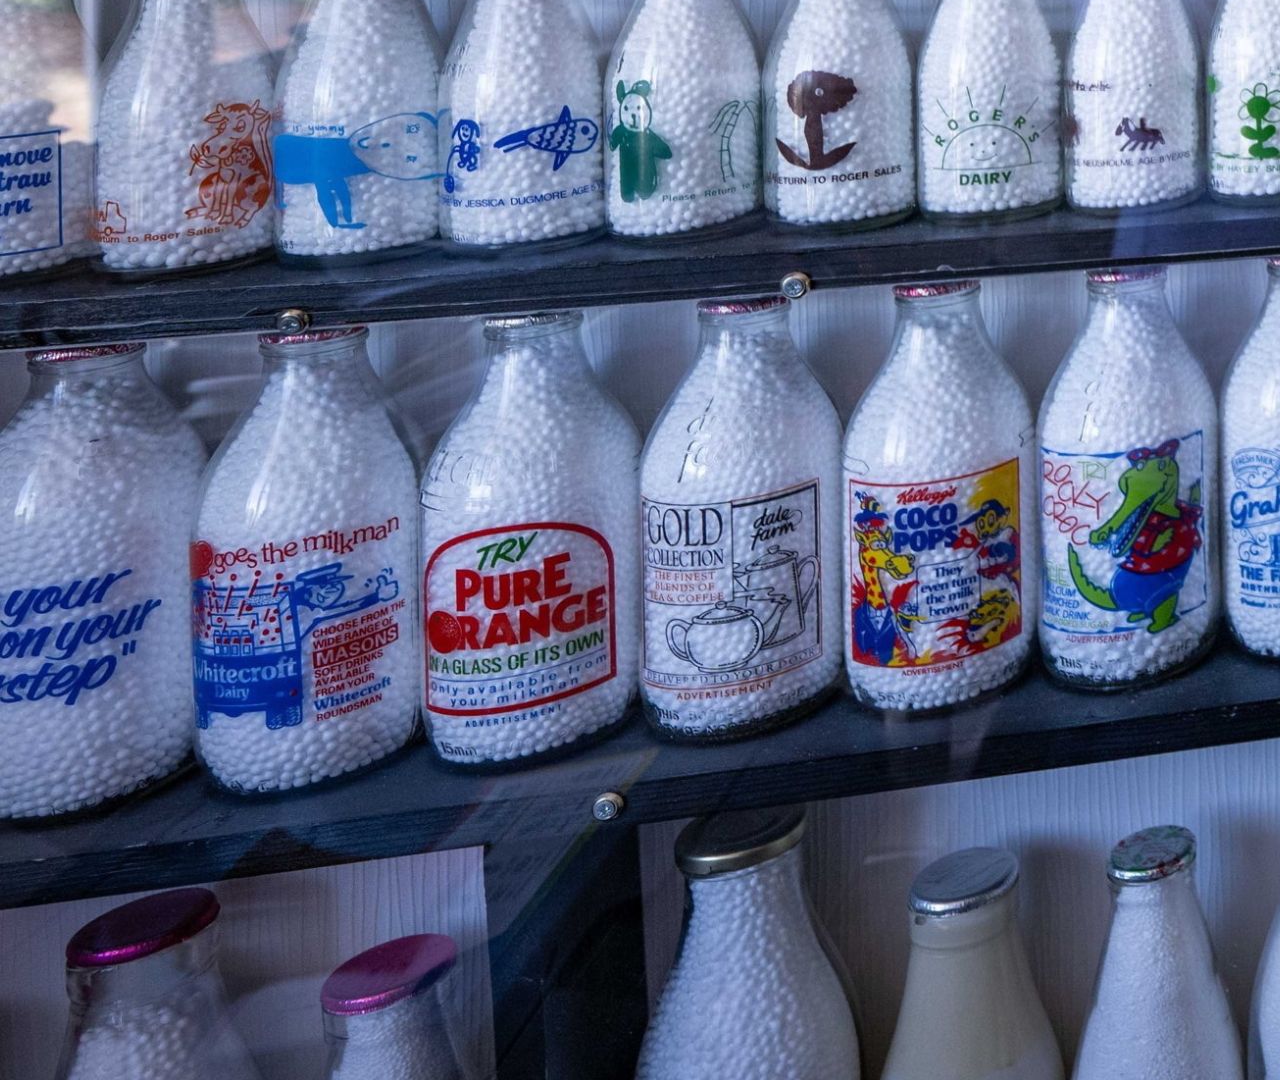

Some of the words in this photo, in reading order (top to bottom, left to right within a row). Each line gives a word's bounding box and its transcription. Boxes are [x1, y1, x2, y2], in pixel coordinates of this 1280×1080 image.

[292, 123, 301, 134] is
[307, 121, 348, 138] yummy
[813, 175, 828, 185] TO
[831, 170, 871, 185] ROGER
[872, 164, 904, 179] SALES
[960, 170, 1012, 187] DAIRY
[1226, 163, 1260, 175] HAYLEY
[453, 198, 464, 208] BY
[465, 197, 507, 209] JESSICA
[509, 190, 569, 207] DUGMORE
[571, 185, 592, 199] AGE
[661, 192, 697, 204] Please
[704, 185, 738, 199] Return
[126, 234, 140, 244] to
[143, 231, 181, 245] Roger
[186, 225, 226, 240] Sales.
[647, 504, 725, 549] GOLD
[893, 502, 959, 533] COCO
[213, 544, 258, 575] goes
[260, 539, 299, 565] the
[301, 515, 400, 557] milkman
[893, 523, 961, 554] POPS
[475, 531, 539, 572] TRY
[454, 551, 573, 612] PURE
[919, 582, 951, 595] even
[950, 574, 978, 590] turn
[931, 564, 965, 581] They
[1239, 563, 1270, 583] THE
[2, 568, 134, 629] your
[927, 600, 970, 619] brown
[428, 584, 609, 654] ORANGE
[314, 628, 398, 668] MASONS
[1064, 632, 1135, 645] ADVERTISEMENT
[312, 674, 393, 713] Whitecroft
[449, 695, 487, 711] your
[495, 675, 580, 705] milkman
